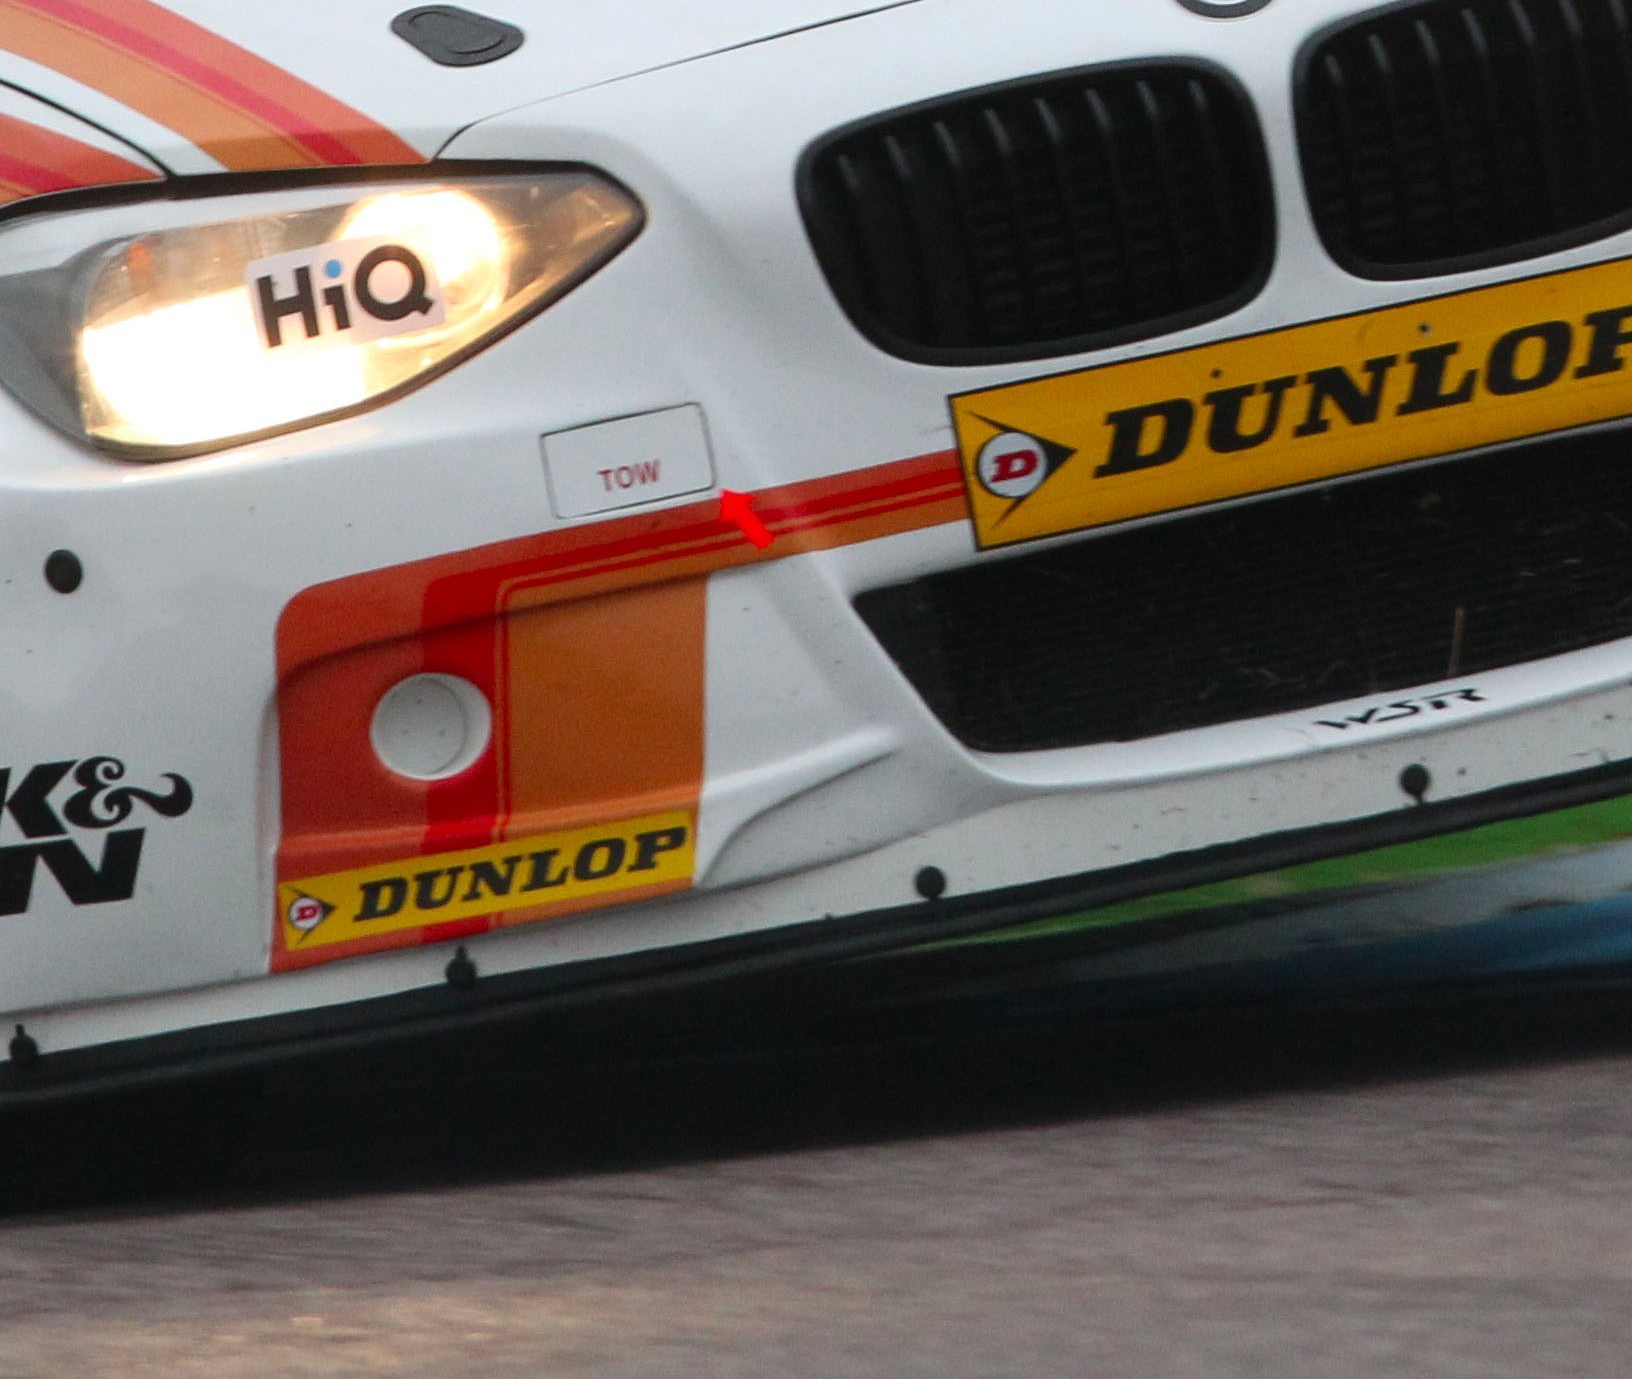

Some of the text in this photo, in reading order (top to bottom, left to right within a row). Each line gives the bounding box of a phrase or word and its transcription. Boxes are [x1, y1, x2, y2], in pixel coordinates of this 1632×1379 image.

[254, 243, 436, 350] HiQ
[597, 458, 662, 492] TOW
[353, 825, 689, 923] DUNLOP
